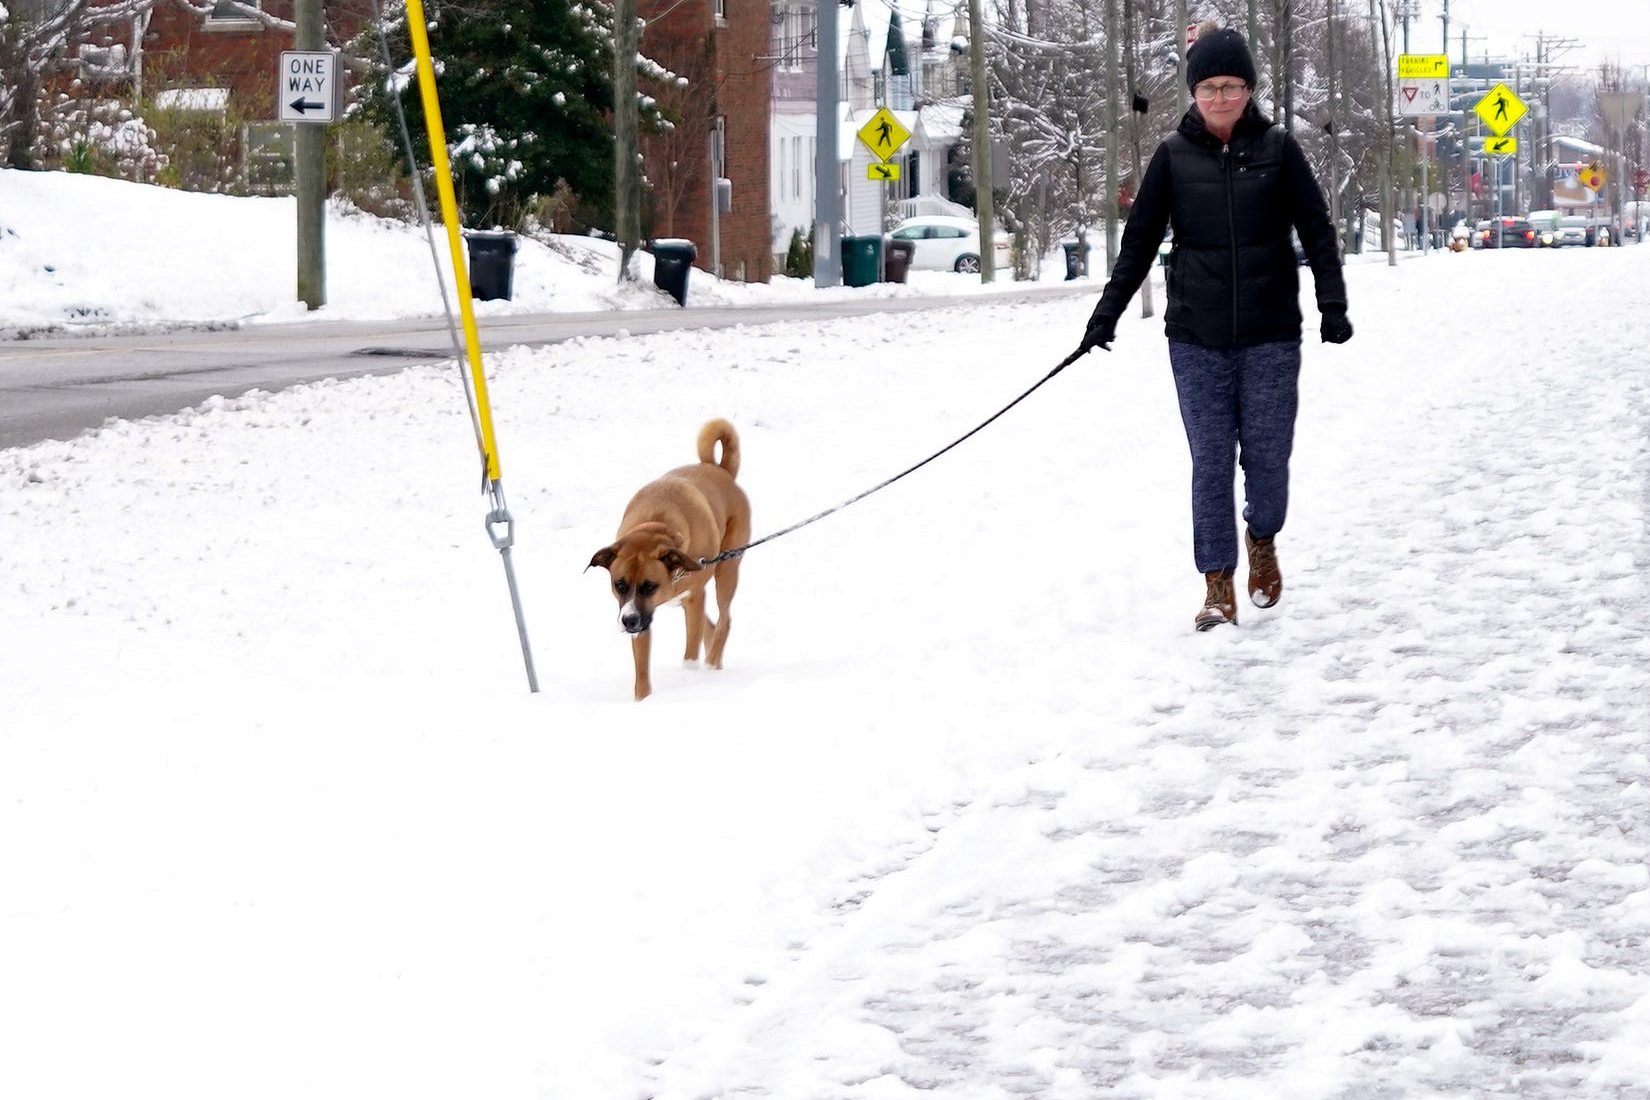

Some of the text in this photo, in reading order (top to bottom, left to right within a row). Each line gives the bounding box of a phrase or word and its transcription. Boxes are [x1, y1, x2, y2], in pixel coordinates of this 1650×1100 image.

[290, 58, 325, 74] ONE
[289, 77, 325, 92] WAY
[1420, 90, 1431, 99] TO
